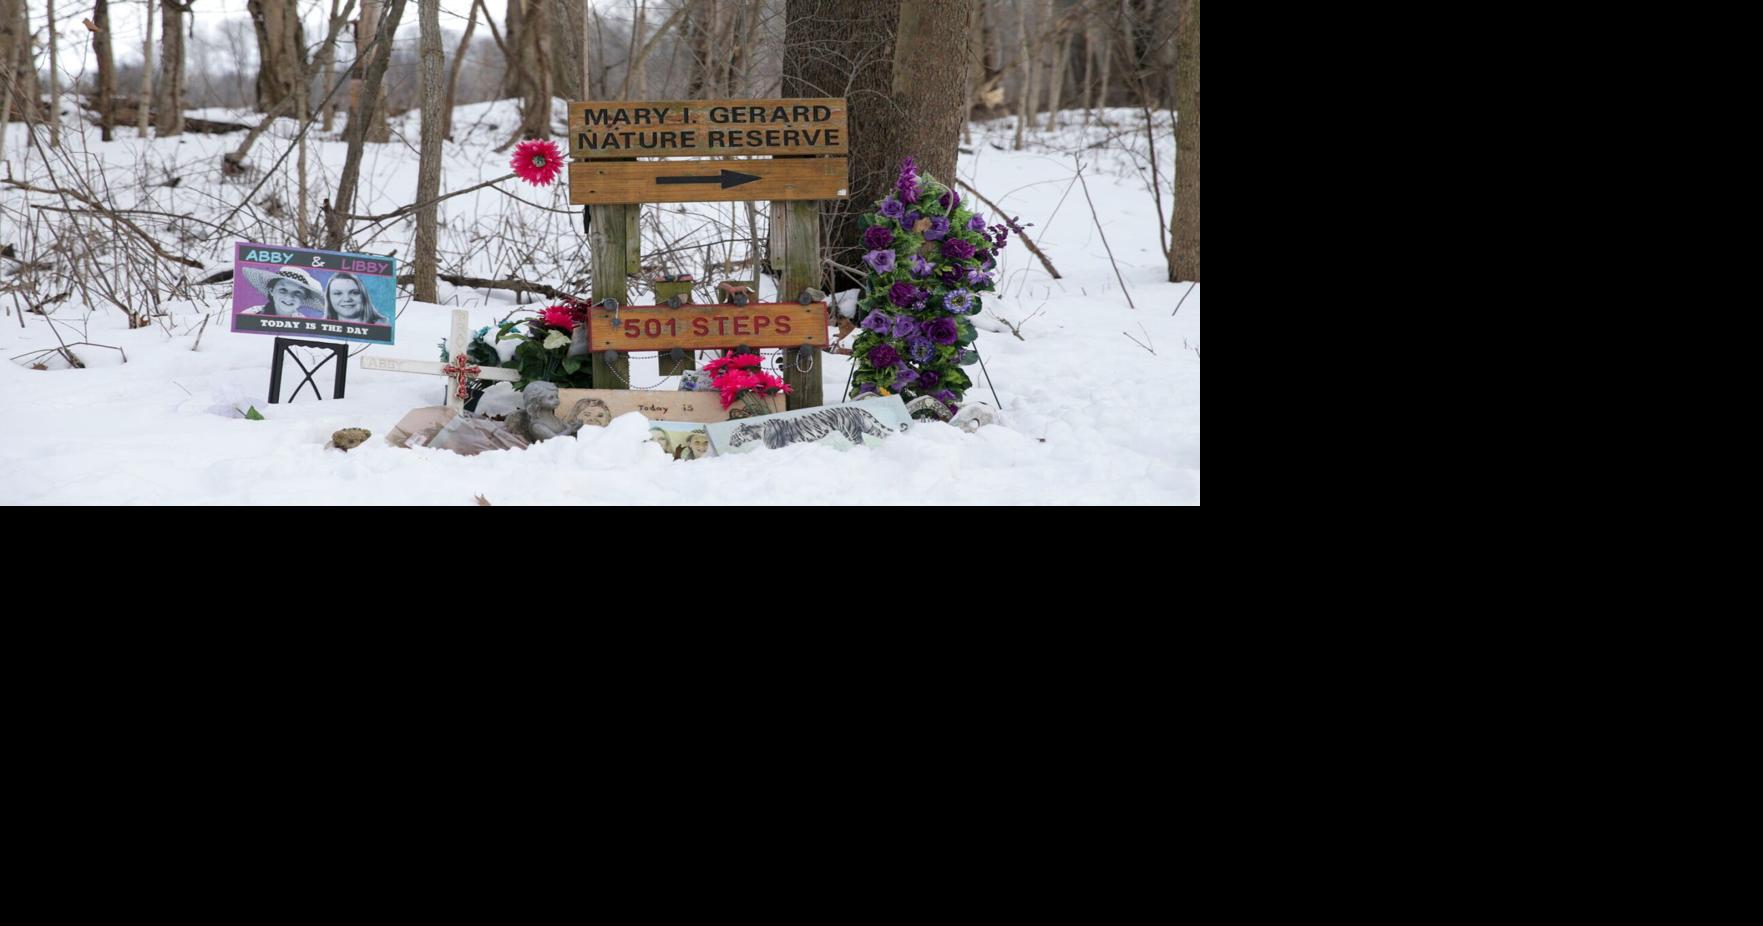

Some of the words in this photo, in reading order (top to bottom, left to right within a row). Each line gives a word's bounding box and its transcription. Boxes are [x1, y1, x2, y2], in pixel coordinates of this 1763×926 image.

[584, 107, 670, 125] MARY
[683, 107, 697, 124] I.
[709, 105, 831, 124] GERARD
[578, 131, 696, 150] NATURE
[708, 129, 840, 148] RESERVE
[245, 249, 294, 263] ABBY
[311, 256, 326, 267] &
[341, 258, 389, 274] LIBBY
[260, 319, 300, 329] TODAY
[305, 322, 317, 330] IS
[321, 324, 343, 333] THE
[346, 327, 369, 335] DAY
[623, 318, 677, 338] 501
[692, 315, 792, 337] STEPS
[638, 404, 669, 414] Today
